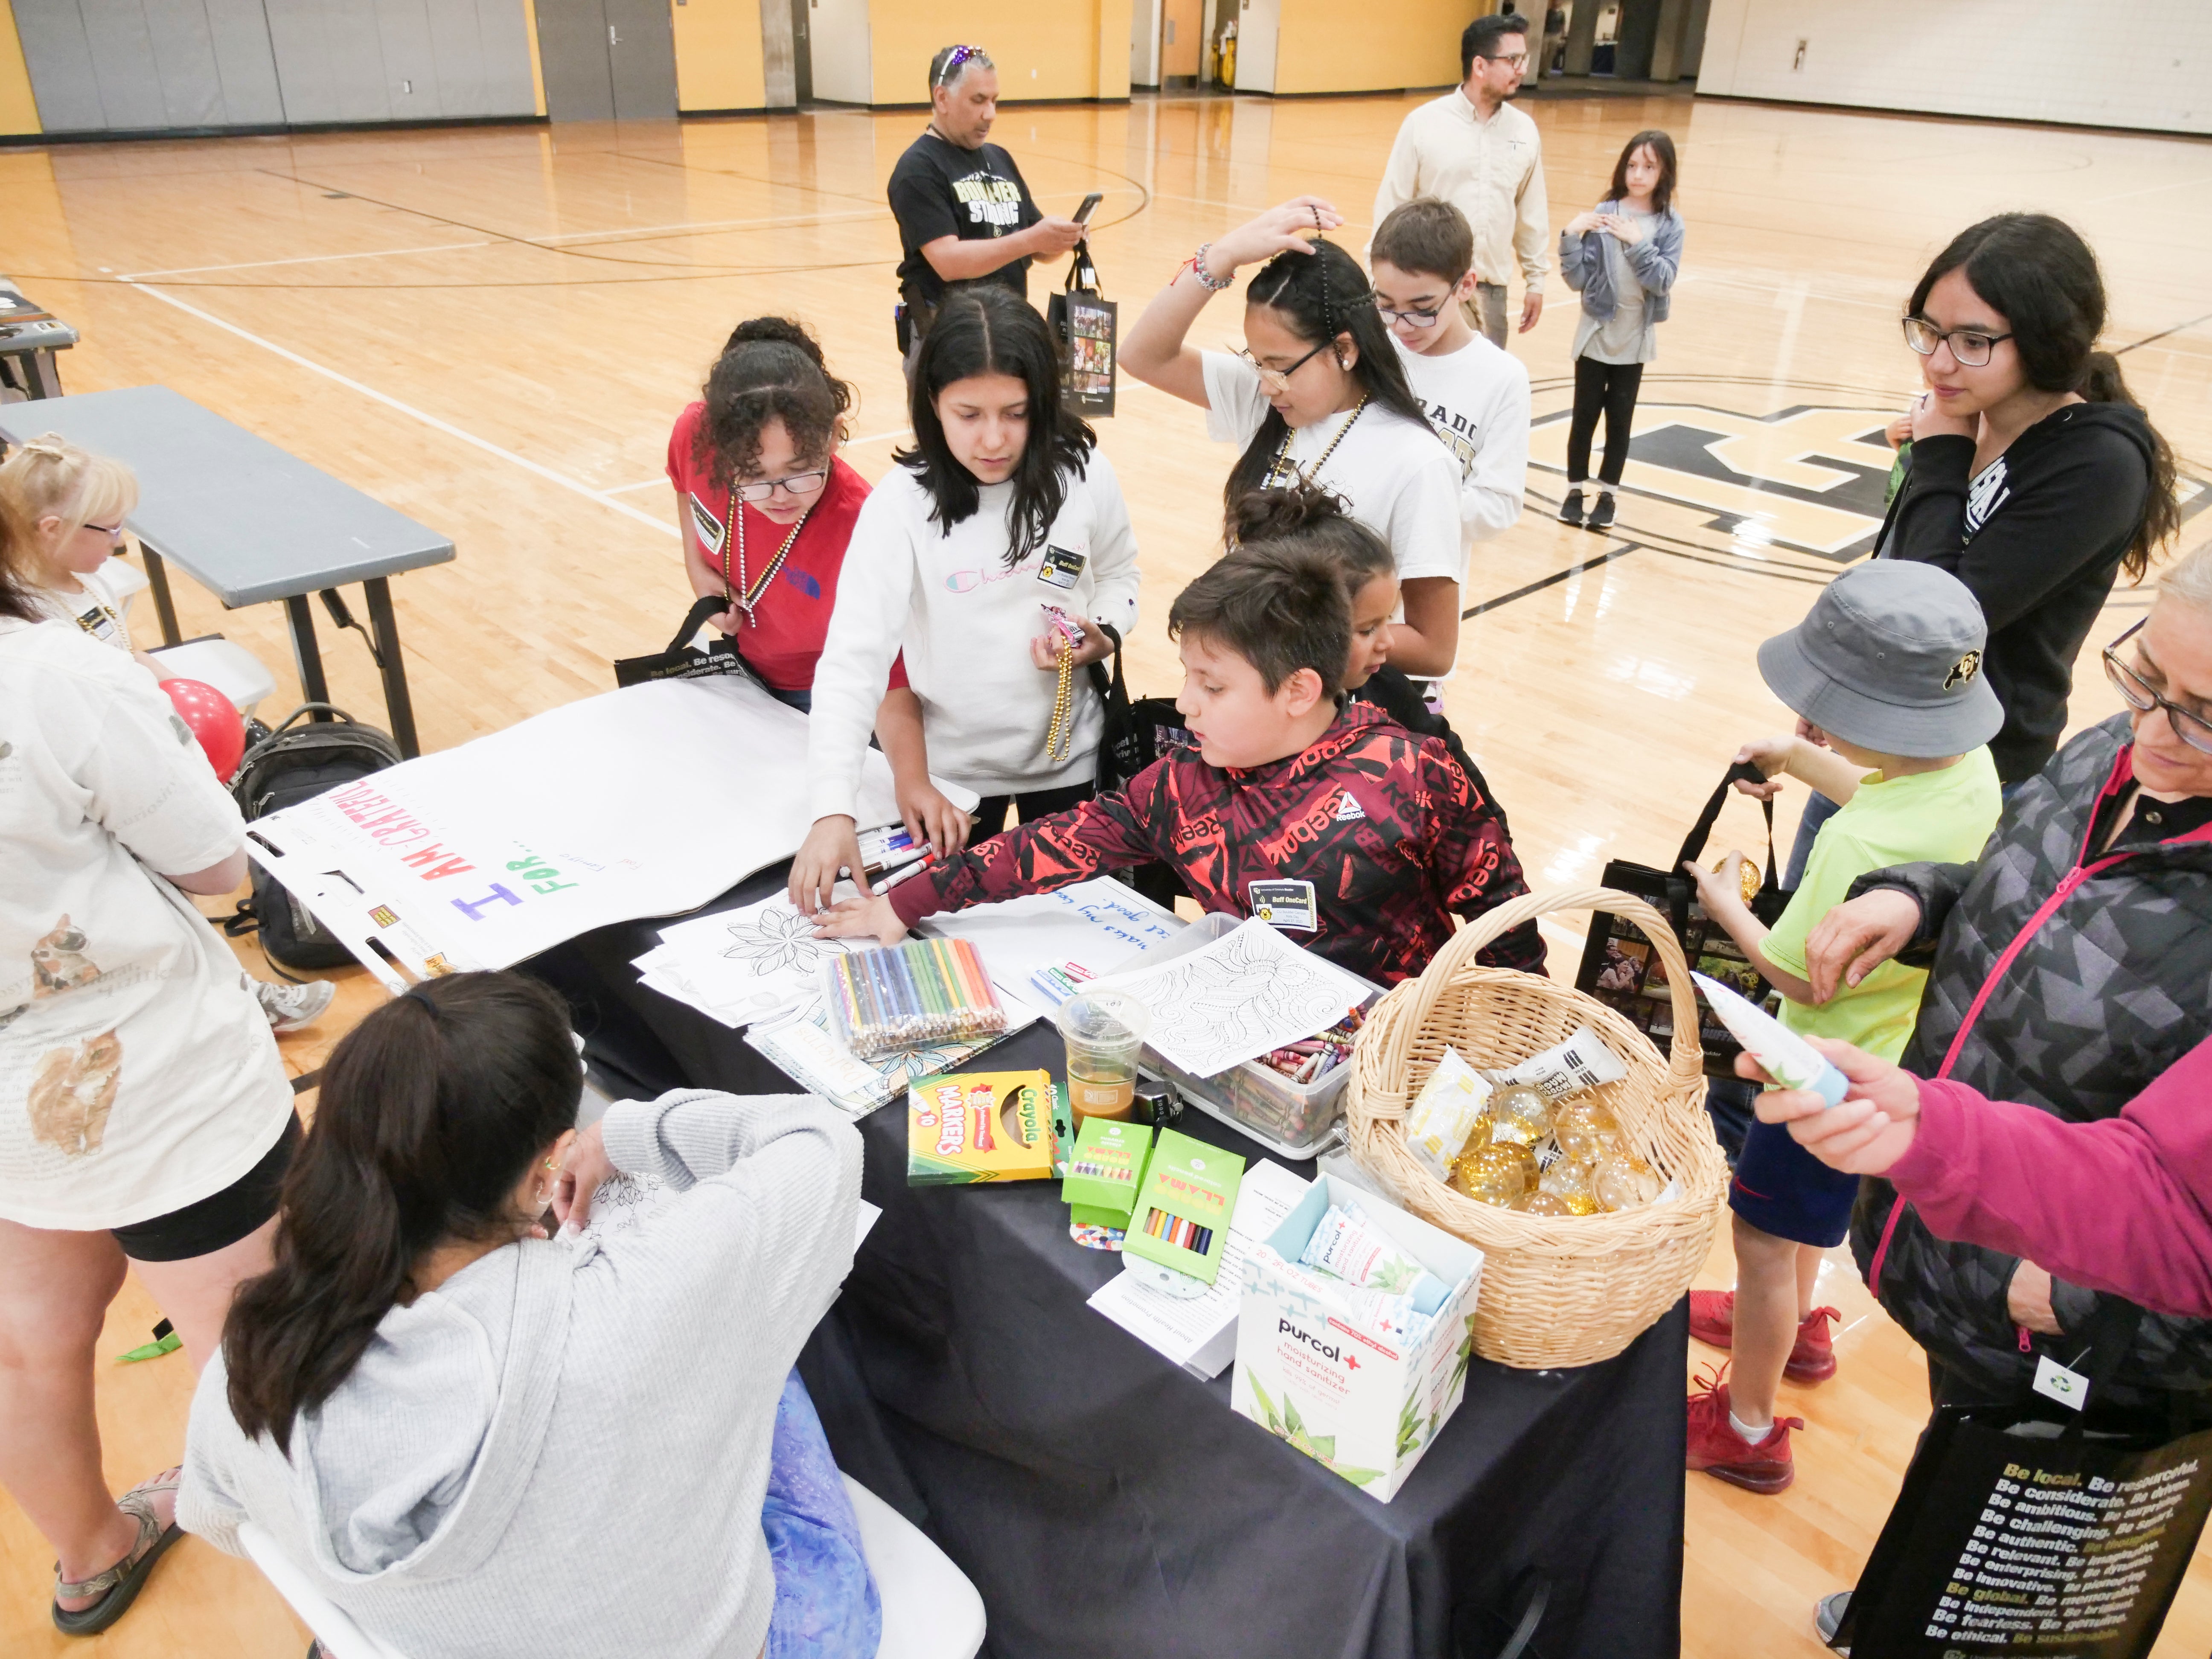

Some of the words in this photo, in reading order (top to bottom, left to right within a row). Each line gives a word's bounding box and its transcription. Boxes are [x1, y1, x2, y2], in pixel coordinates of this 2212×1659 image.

[693, 658, 707, 666] Be
[329, 780, 430, 846] GRATEFUL
[1336, 810, 1365, 821] Reebok
[400, 843, 477, 881] AM
[450, 883, 524, 922] I
[1077, 905, 1103, 923] my
[1102, 898, 1150, 921] good.
[1103, 926, 1148, 950] makes
[1051, 1095, 1059, 1110] Classic
[920, 1115, 937, 1126] 10
[935, 1085, 966, 1155] MARKERS
[1019, 1089, 1042, 1142] Crayola
[1087, 1146, 1132, 1159] LLAMA
[1100, 1136, 1125, 1144] crayons
[1168, 1164, 1193, 1178] pencils
[1194, 1175, 1222, 1188] colored
[1158, 1173, 1225, 1206] LLAMA
[1323, 1230, 1342, 1264] purcol
[1335, 1230, 1359, 1268] moisturizing
[1256, 1249, 1266, 1259] 20
[1272, 1259, 1284, 1271] 2FL
[1286, 1268, 1300, 1280] OZ
[1300, 1276, 1323, 1293] TUBES
[1340, 1258, 1349, 1275] hand
[1121, 1294, 1153, 1318] Promotion
[1153, 1314, 1174, 1331] Health
[1173, 1328, 1194, 1343] About
[1278, 1317, 1340, 1362] purcol
[1351, 1329, 1362, 1341] 70%
[1362, 1337, 1378, 1349] ethyl
[1377, 1345, 1399, 1360] alcohol
[1277, 1345, 1302, 1368] hand
[1306, 1366, 1351, 1394] sanitizer
[1284, 1342, 1345, 1384] moisturizing
[1295, 1374, 1307, 1386] 99%
[2003, 1463, 2030, 1480] Be
[2032, 1468, 2082, 1487] local.
[2087, 1476, 2115, 1493] Be
[1995, 1478, 2020, 1495] Be
[2024, 1487, 2125, 1508] considerate.
[1988, 1493, 2011, 1508] Be
[2014, 1502, 2098, 1522] ambitious.
[1980, 1508, 2005, 1525] Be
[2009, 1517, 2110, 1540] challenging.
[1973, 1524, 1996, 1540] Be
[1998, 1533, 2078, 1553] authentic.
[1965, 1539, 1989, 1554] Be
[1991, 1546, 2061, 1566] relevant.
[1953, 1567, 1974, 1581] Be
[1976, 1571, 2056, 1592] innovative.
[1959, 1553, 1981, 1566] Be
[1984, 1560, 2078, 1581] enterprising.
[1946, 1581, 1969, 1596] Be
[1938, 1595, 1961, 1609] Be
[1932, 1608, 1958, 1624] Be
[1961, 1614, 2034, 1630] fearless.
[1925, 1624, 1948, 1639] Be
[1950, 1630, 2008, 1644] ethical.
